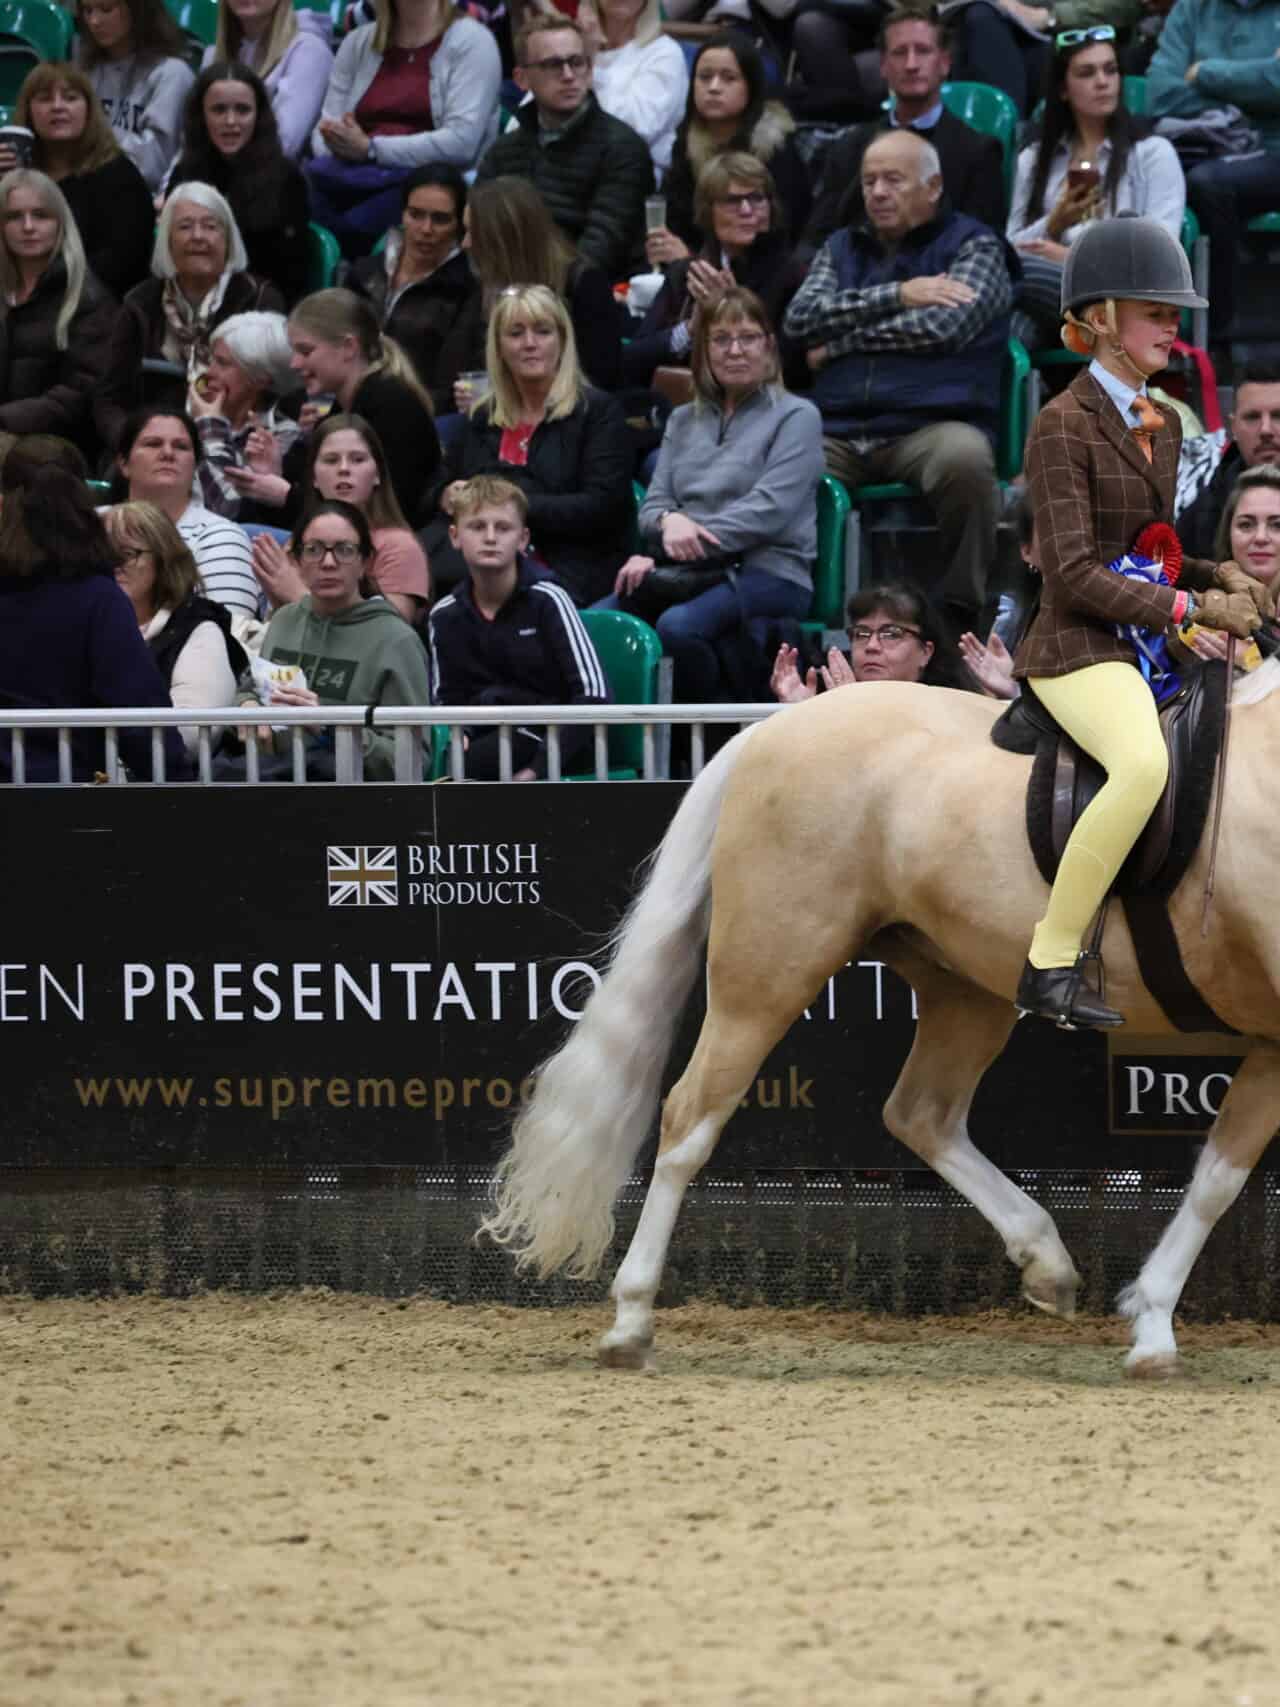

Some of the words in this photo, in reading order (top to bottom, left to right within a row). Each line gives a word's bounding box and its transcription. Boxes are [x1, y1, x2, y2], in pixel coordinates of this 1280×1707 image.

[407, 843, 538, 876] BRITISH
[407, 880, 542, 906] PRODUCTS
[122, 961, 602, 1022] PRESENTATIO
